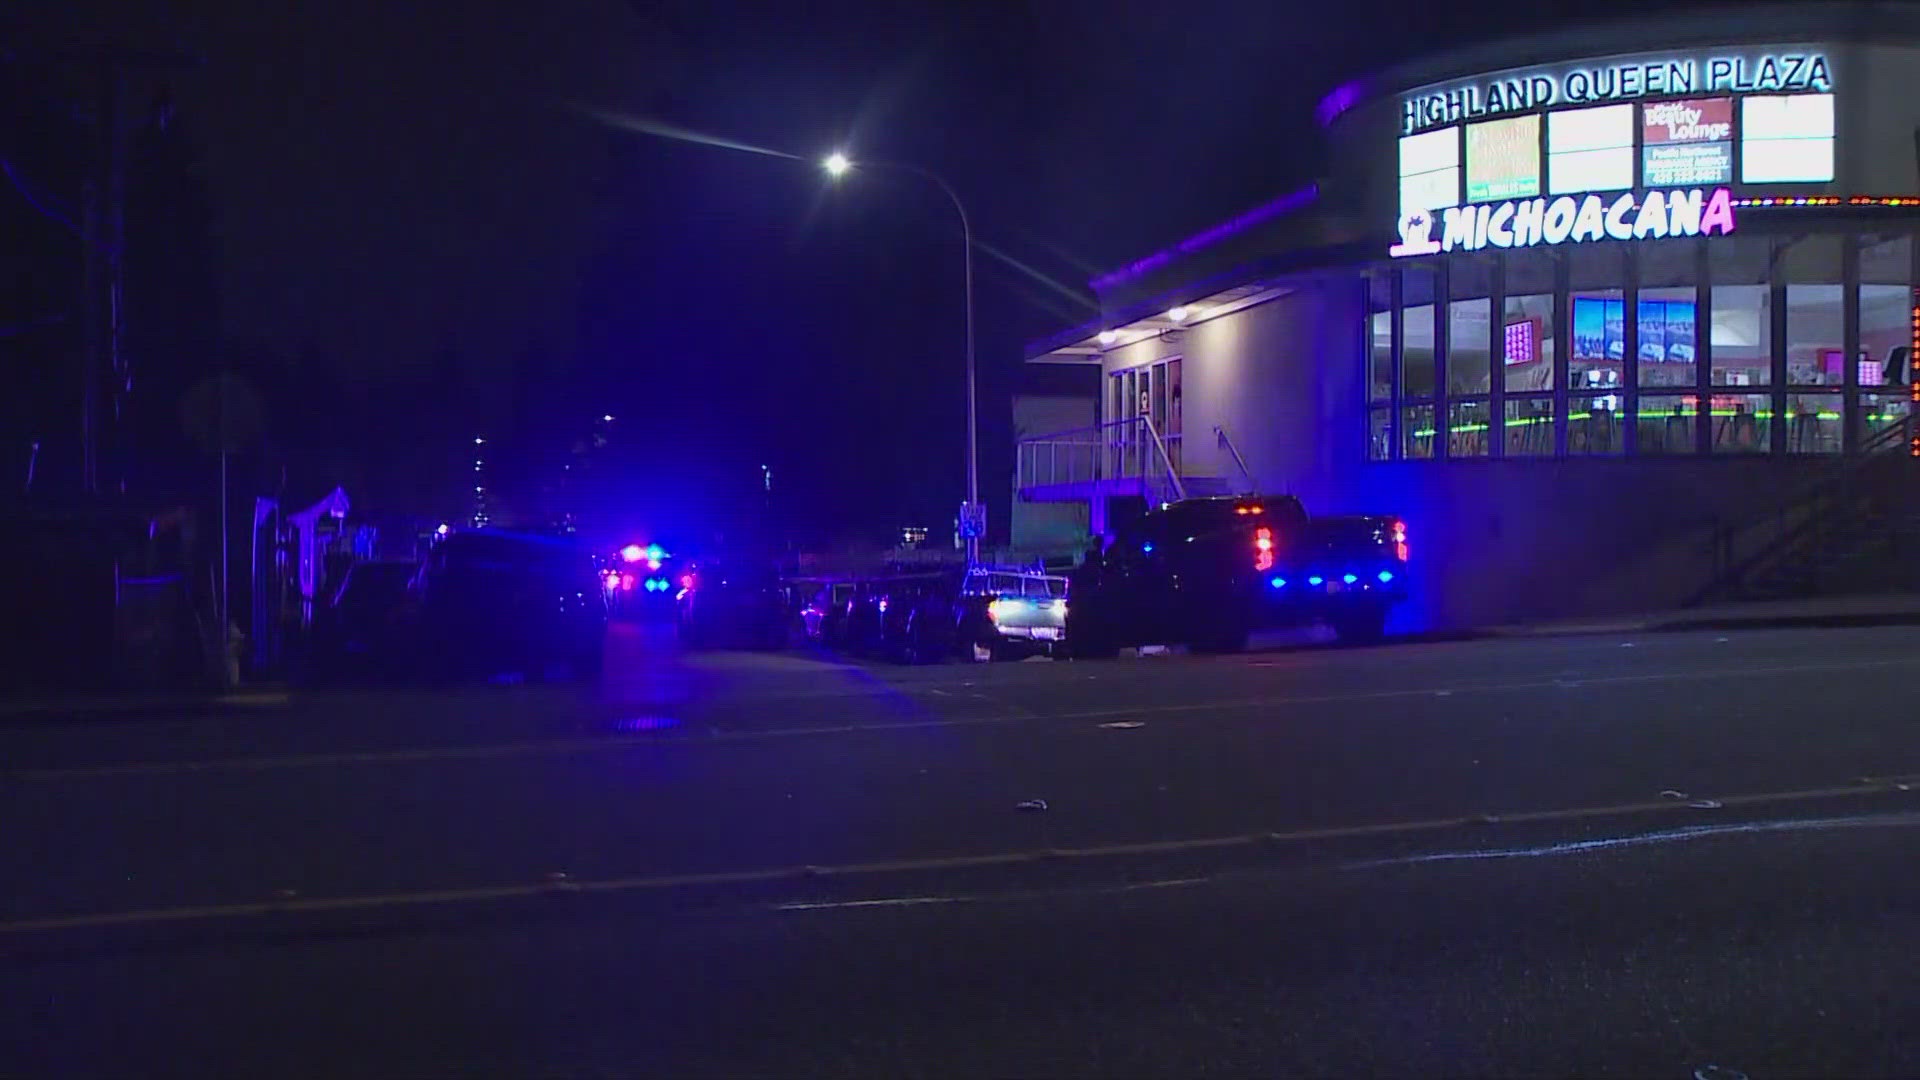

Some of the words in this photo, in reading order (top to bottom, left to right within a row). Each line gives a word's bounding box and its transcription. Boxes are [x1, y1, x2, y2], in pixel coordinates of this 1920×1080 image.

[1403, 77, 1553, 133] HIGHLAND
[1566, 63, 1694, 102] QUEEN
[1710, 56, 1831, 91] PLAZA
[1645, 107, 1701, 127] Beauty
[1668, 123, 1729, 140] Lounge
[1443, 188, 1735, 251] MICHOACANA
